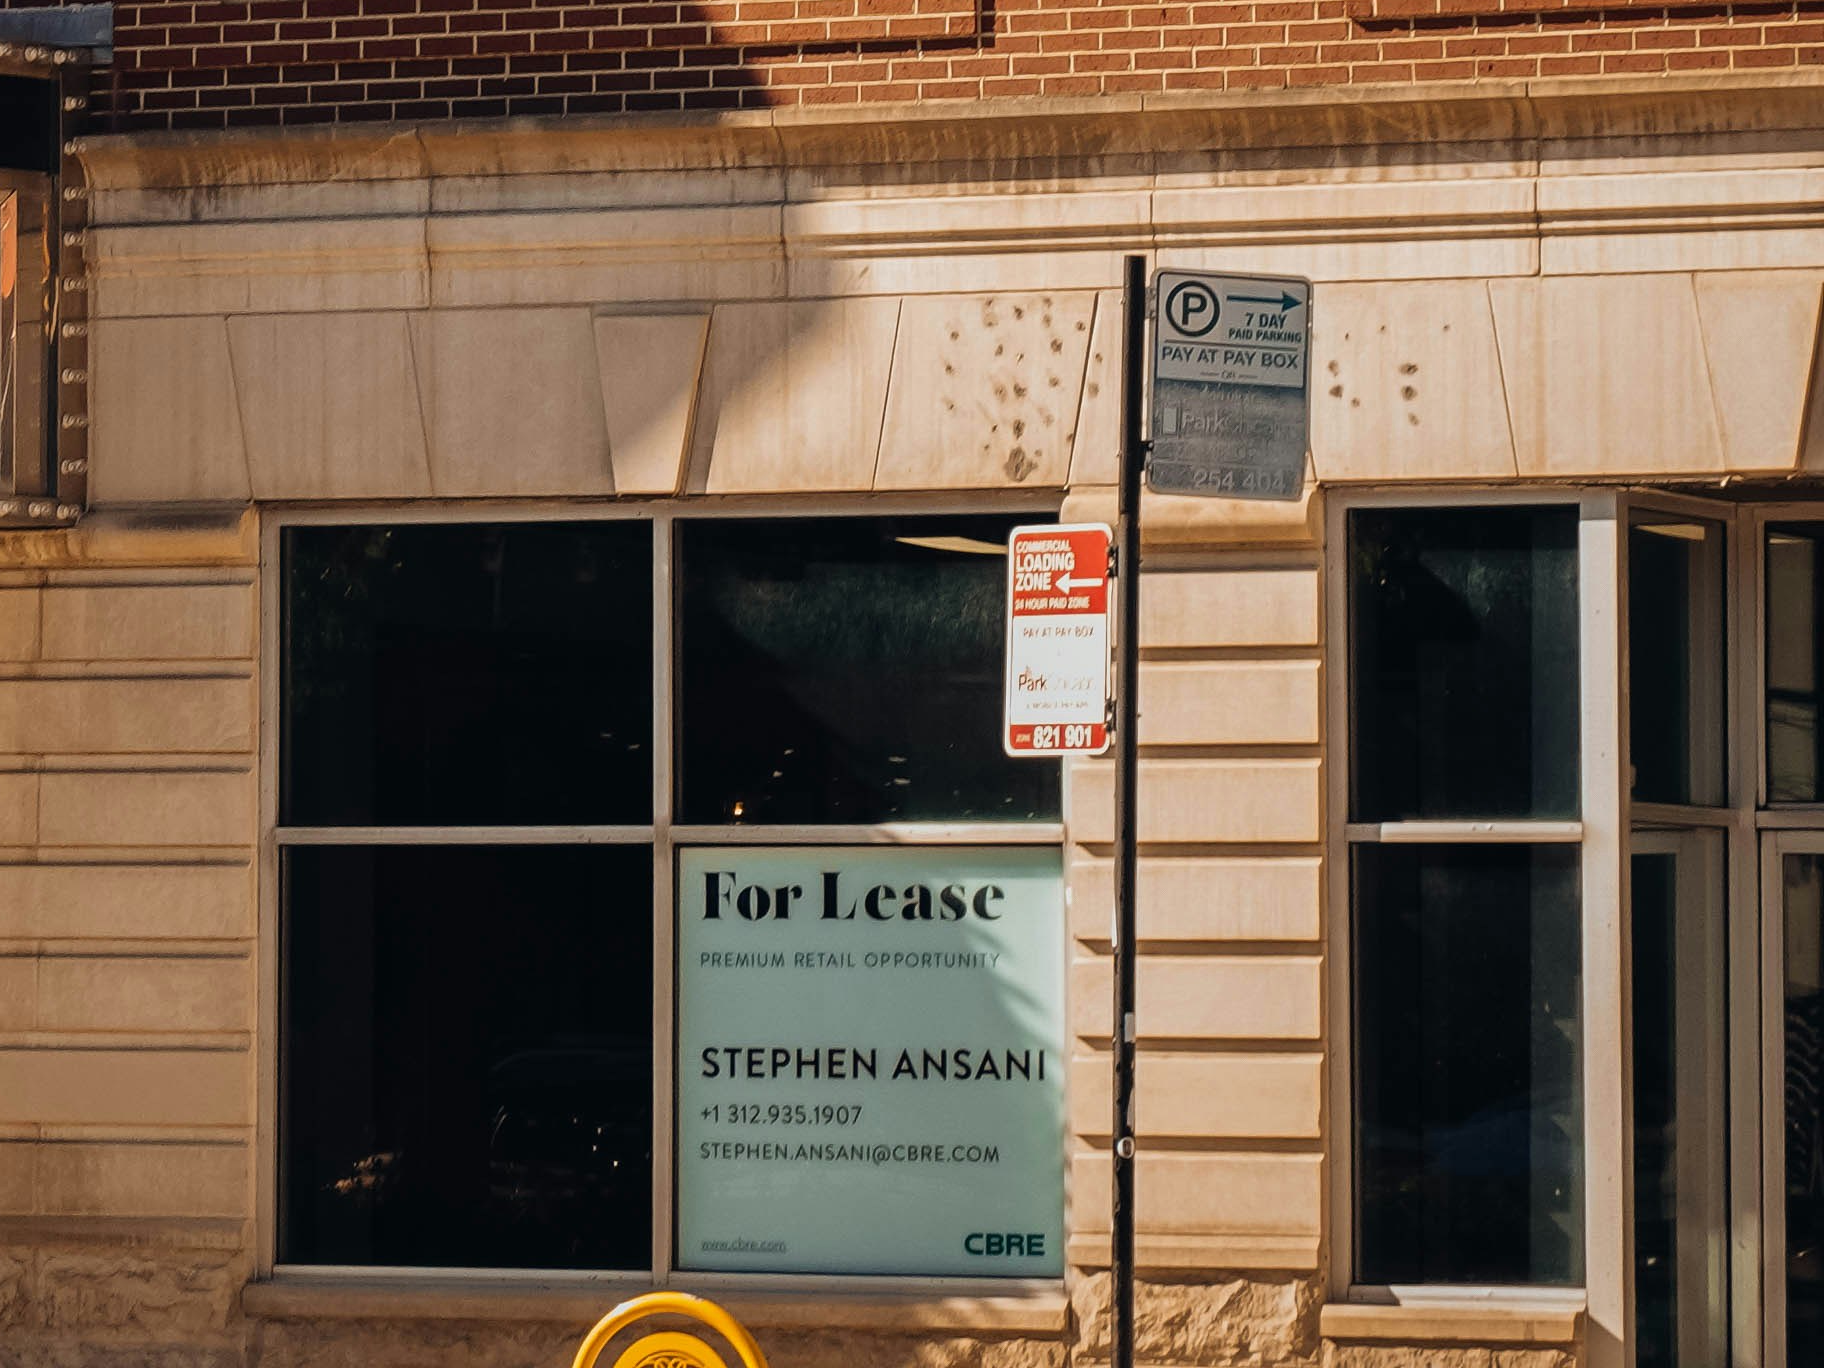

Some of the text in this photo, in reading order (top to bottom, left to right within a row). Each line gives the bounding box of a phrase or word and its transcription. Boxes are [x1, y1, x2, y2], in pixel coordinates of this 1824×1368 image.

[1244, 312, 1287, 330] 7 DAY
[1228, 327, 1303, 344] PAID PARKING
[1162, 346, 1298, 371] PAY AT PAY BOX
[1015, 539, 1072, 554] COMMERCIAL
[1016, 552, 1075, 572] LOADING
[1015, 572, 1052, 592] ZONE
[1026, 598, 1048, 611] HOUR
[1049, 597, 1068, 610] PAID
[1068, 596, 1090, 609] ZONE
[1018, 673, 1047, 692] Park
[702, 871, 1006, 922] For Lease
[700, 951, 1001, 970] PREMIUM RETAIL OPPORTUNITY
[701, 1047, 1046, 1081] STEPHEN ANSANI
[700, 1104, 863, 1126] +1 312.935.1907
[699, 1142, 1000, 1165] STEPHEN.ANSANI@CBRE.COM
[964, 1233, 1046, 1257] CBRE
